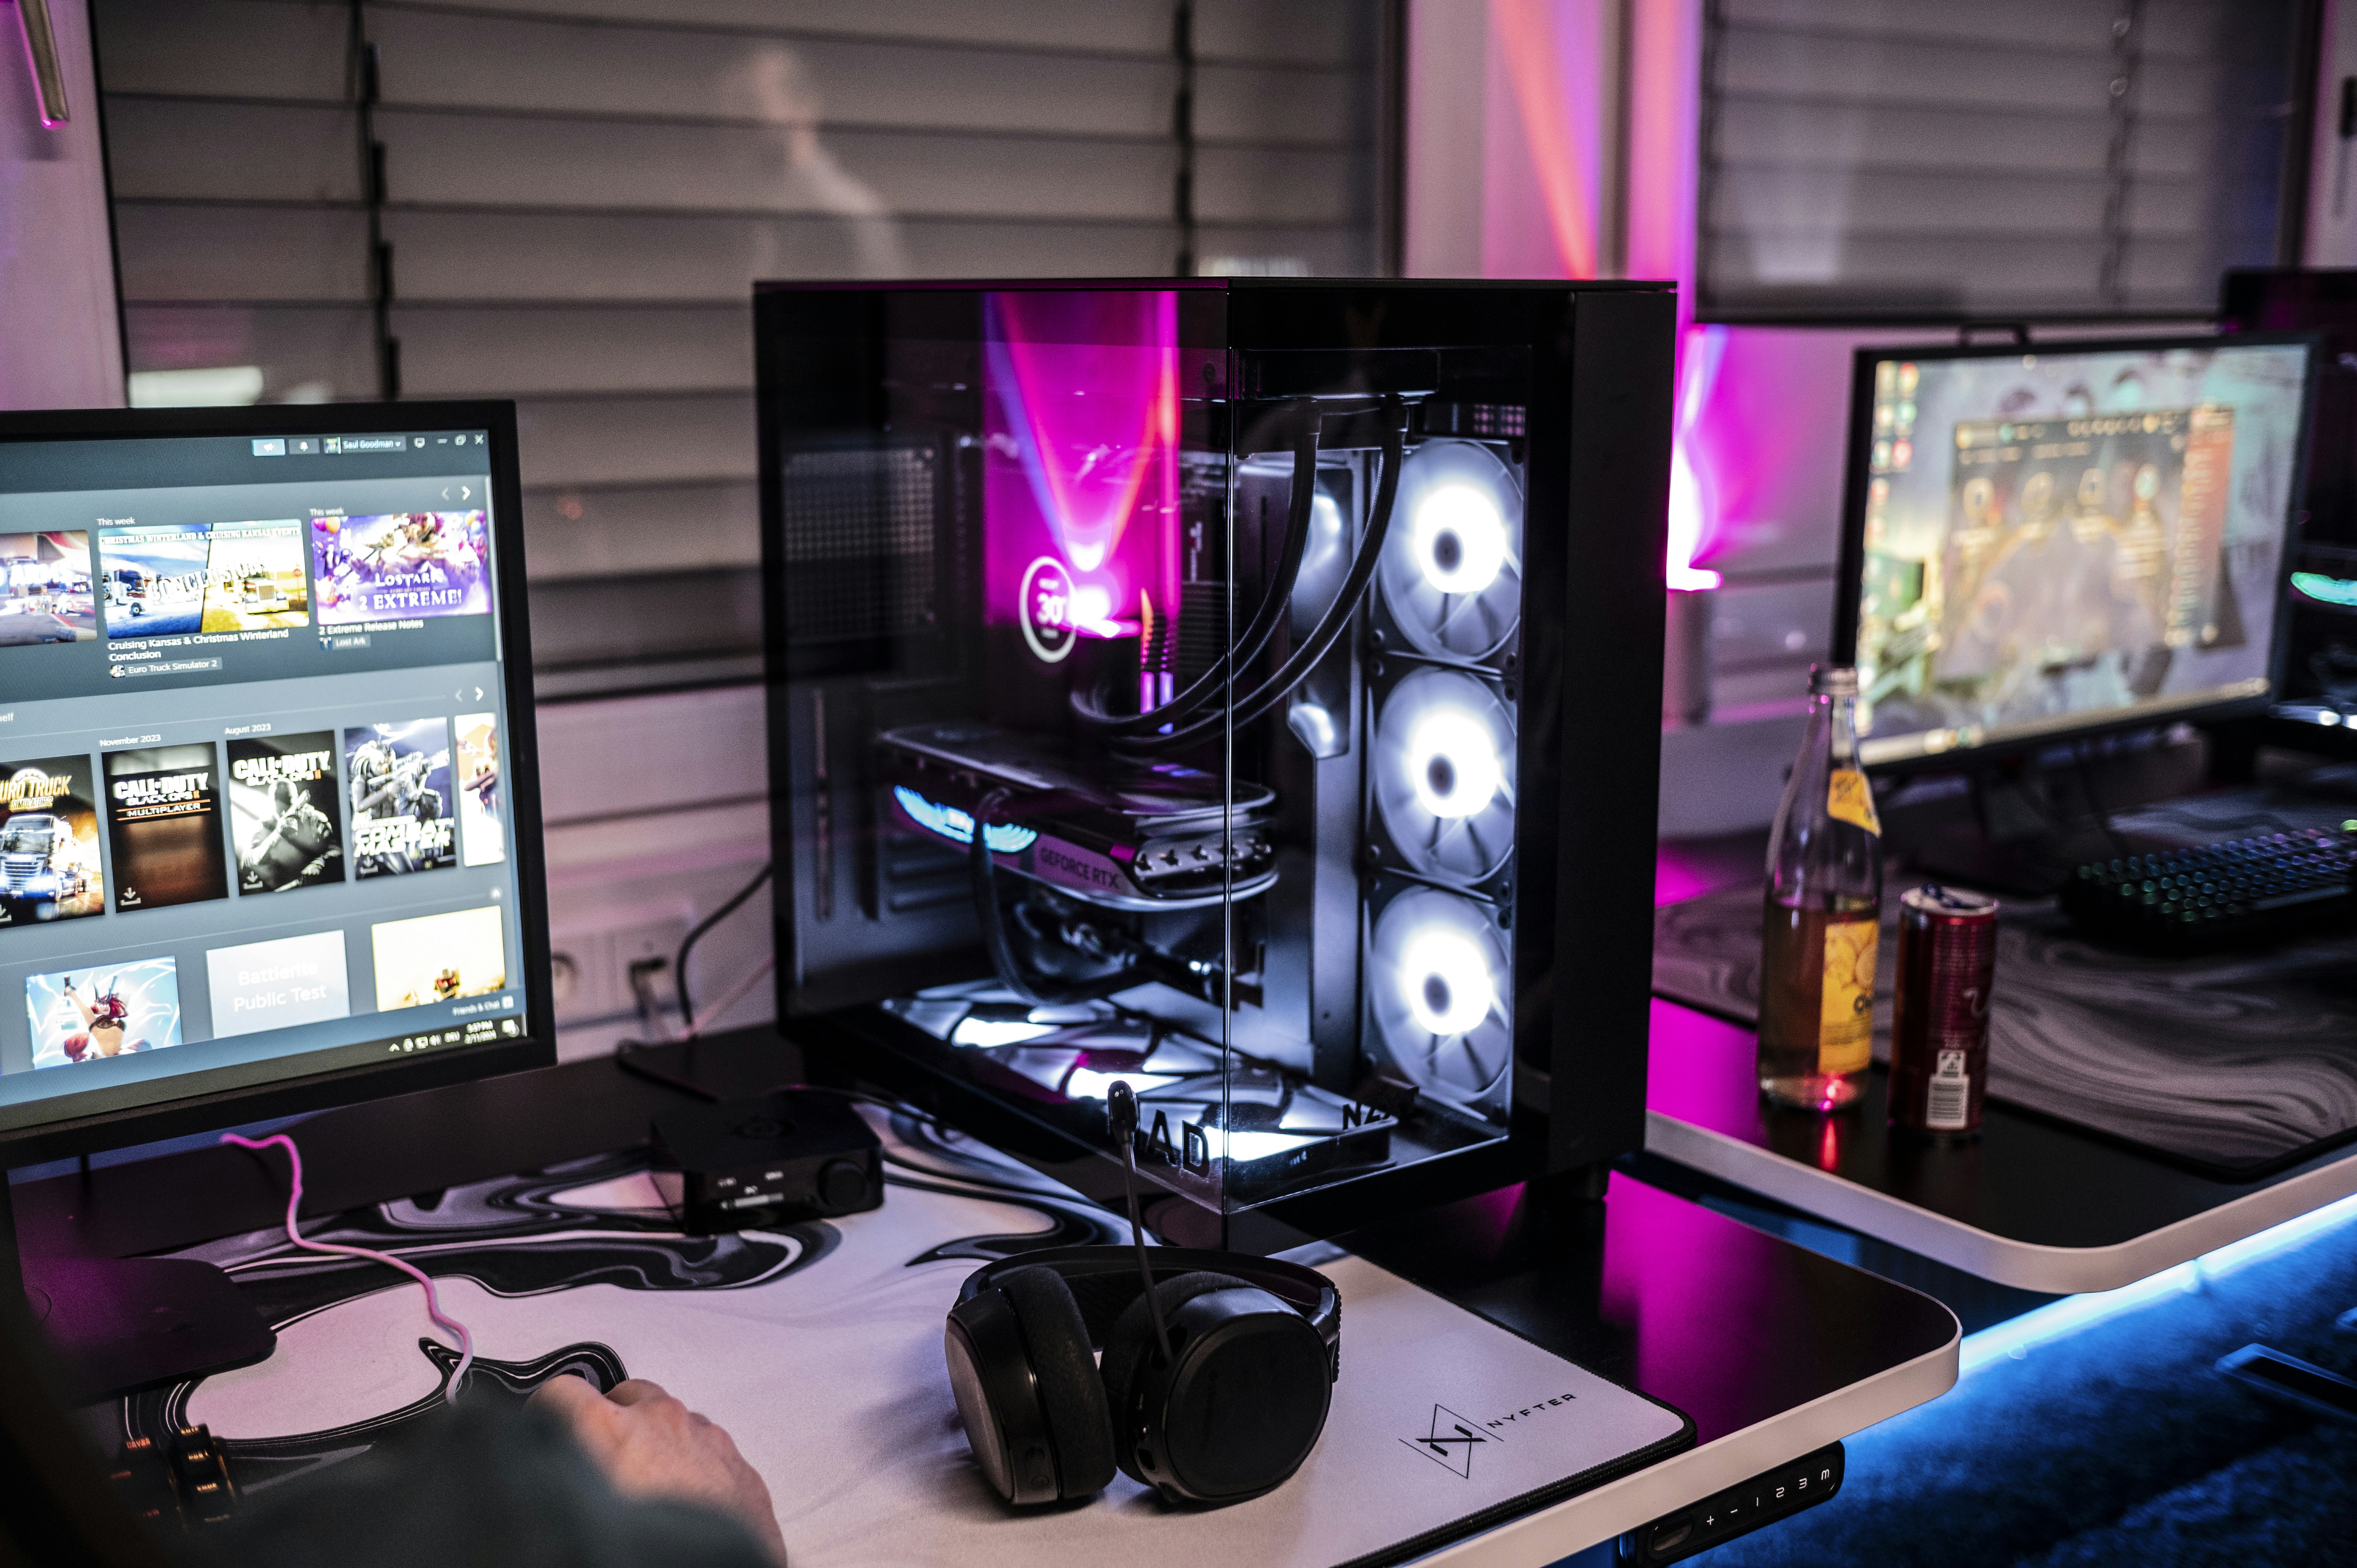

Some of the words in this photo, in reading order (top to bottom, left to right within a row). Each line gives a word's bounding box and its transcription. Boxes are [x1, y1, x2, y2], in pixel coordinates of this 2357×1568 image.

[342, 440, 358, 449] Saul
[359, 439, 393, 449] Goodman
[310, 508, 324, 517] This
[325, 506, 344, 516] week
[99, 535, 145, 544] CHRISTMAS
[145, 532, 197, 543] WINTERLAND
[198, 532, 205, 540] &
[206, 530, 241, 540] CRUISING
[242, 528, 271, 538] KANSAS
[148, 558, 265, 601] CONCLUSION
[359, 595, 368, 611] 2
[373, 588, 462, 610] EXTREME!
[319, 626, 325, 636] 2
[327, 624, 363, 635] Extreme
[398, 619, 424, 630] Notes
[108, 641, 147, 650] Cruising
[148, 638, 182, 647] Kansas
[183, 636, 192, 645] &
[193, 634, 239, 644] Christmas
[239, 628, 289, 641] Winterland
[336, 638, 352, 647] Lost
[108, 651, 161, 661] Conclusion
[149, 663, 171, 672] Truck
[172, 660, 210, 670] Simulator
[225, 725, 251, 735] August
[251, 723, 271, 733] 2023
[100, 736, 139, 747] November
[140, 734, 161, 744] 2023
[233, 757, 279, 779] CALL
[280, 750, 331, 774] DUTY
[0, 780, 26, 803] URO
[29, 775, 72, 799] TRUCK
[113, 778, 159, 799] CALL
[160, 772, 209, 794] DUTY
[11, 797, 46, 810] SIMULATOR
[48, 797, 53, 806] 2
[126, 794, 168, 806] BLACK
[168, 791, 192, 802] OPS
[126, 802, 201, 817] MULTIPLAYER
[355, 817, 455, 844] COMBAT
[354, 830, 451, 859] MASTER
[1041, 846, 1090, 881] GEFORCE
[1092, 866, 1119, 888] RTX
[238, 962, 319, 986] Battlerite
[234, 992, 286, 1012] Public
[290, 984, 327, 1002] Test
[1486, 1394, 1577, 1429] NYFTER
[1776, 1487, 1784, 1498] 2
[1799, 1478, 1807, 1489] 3
